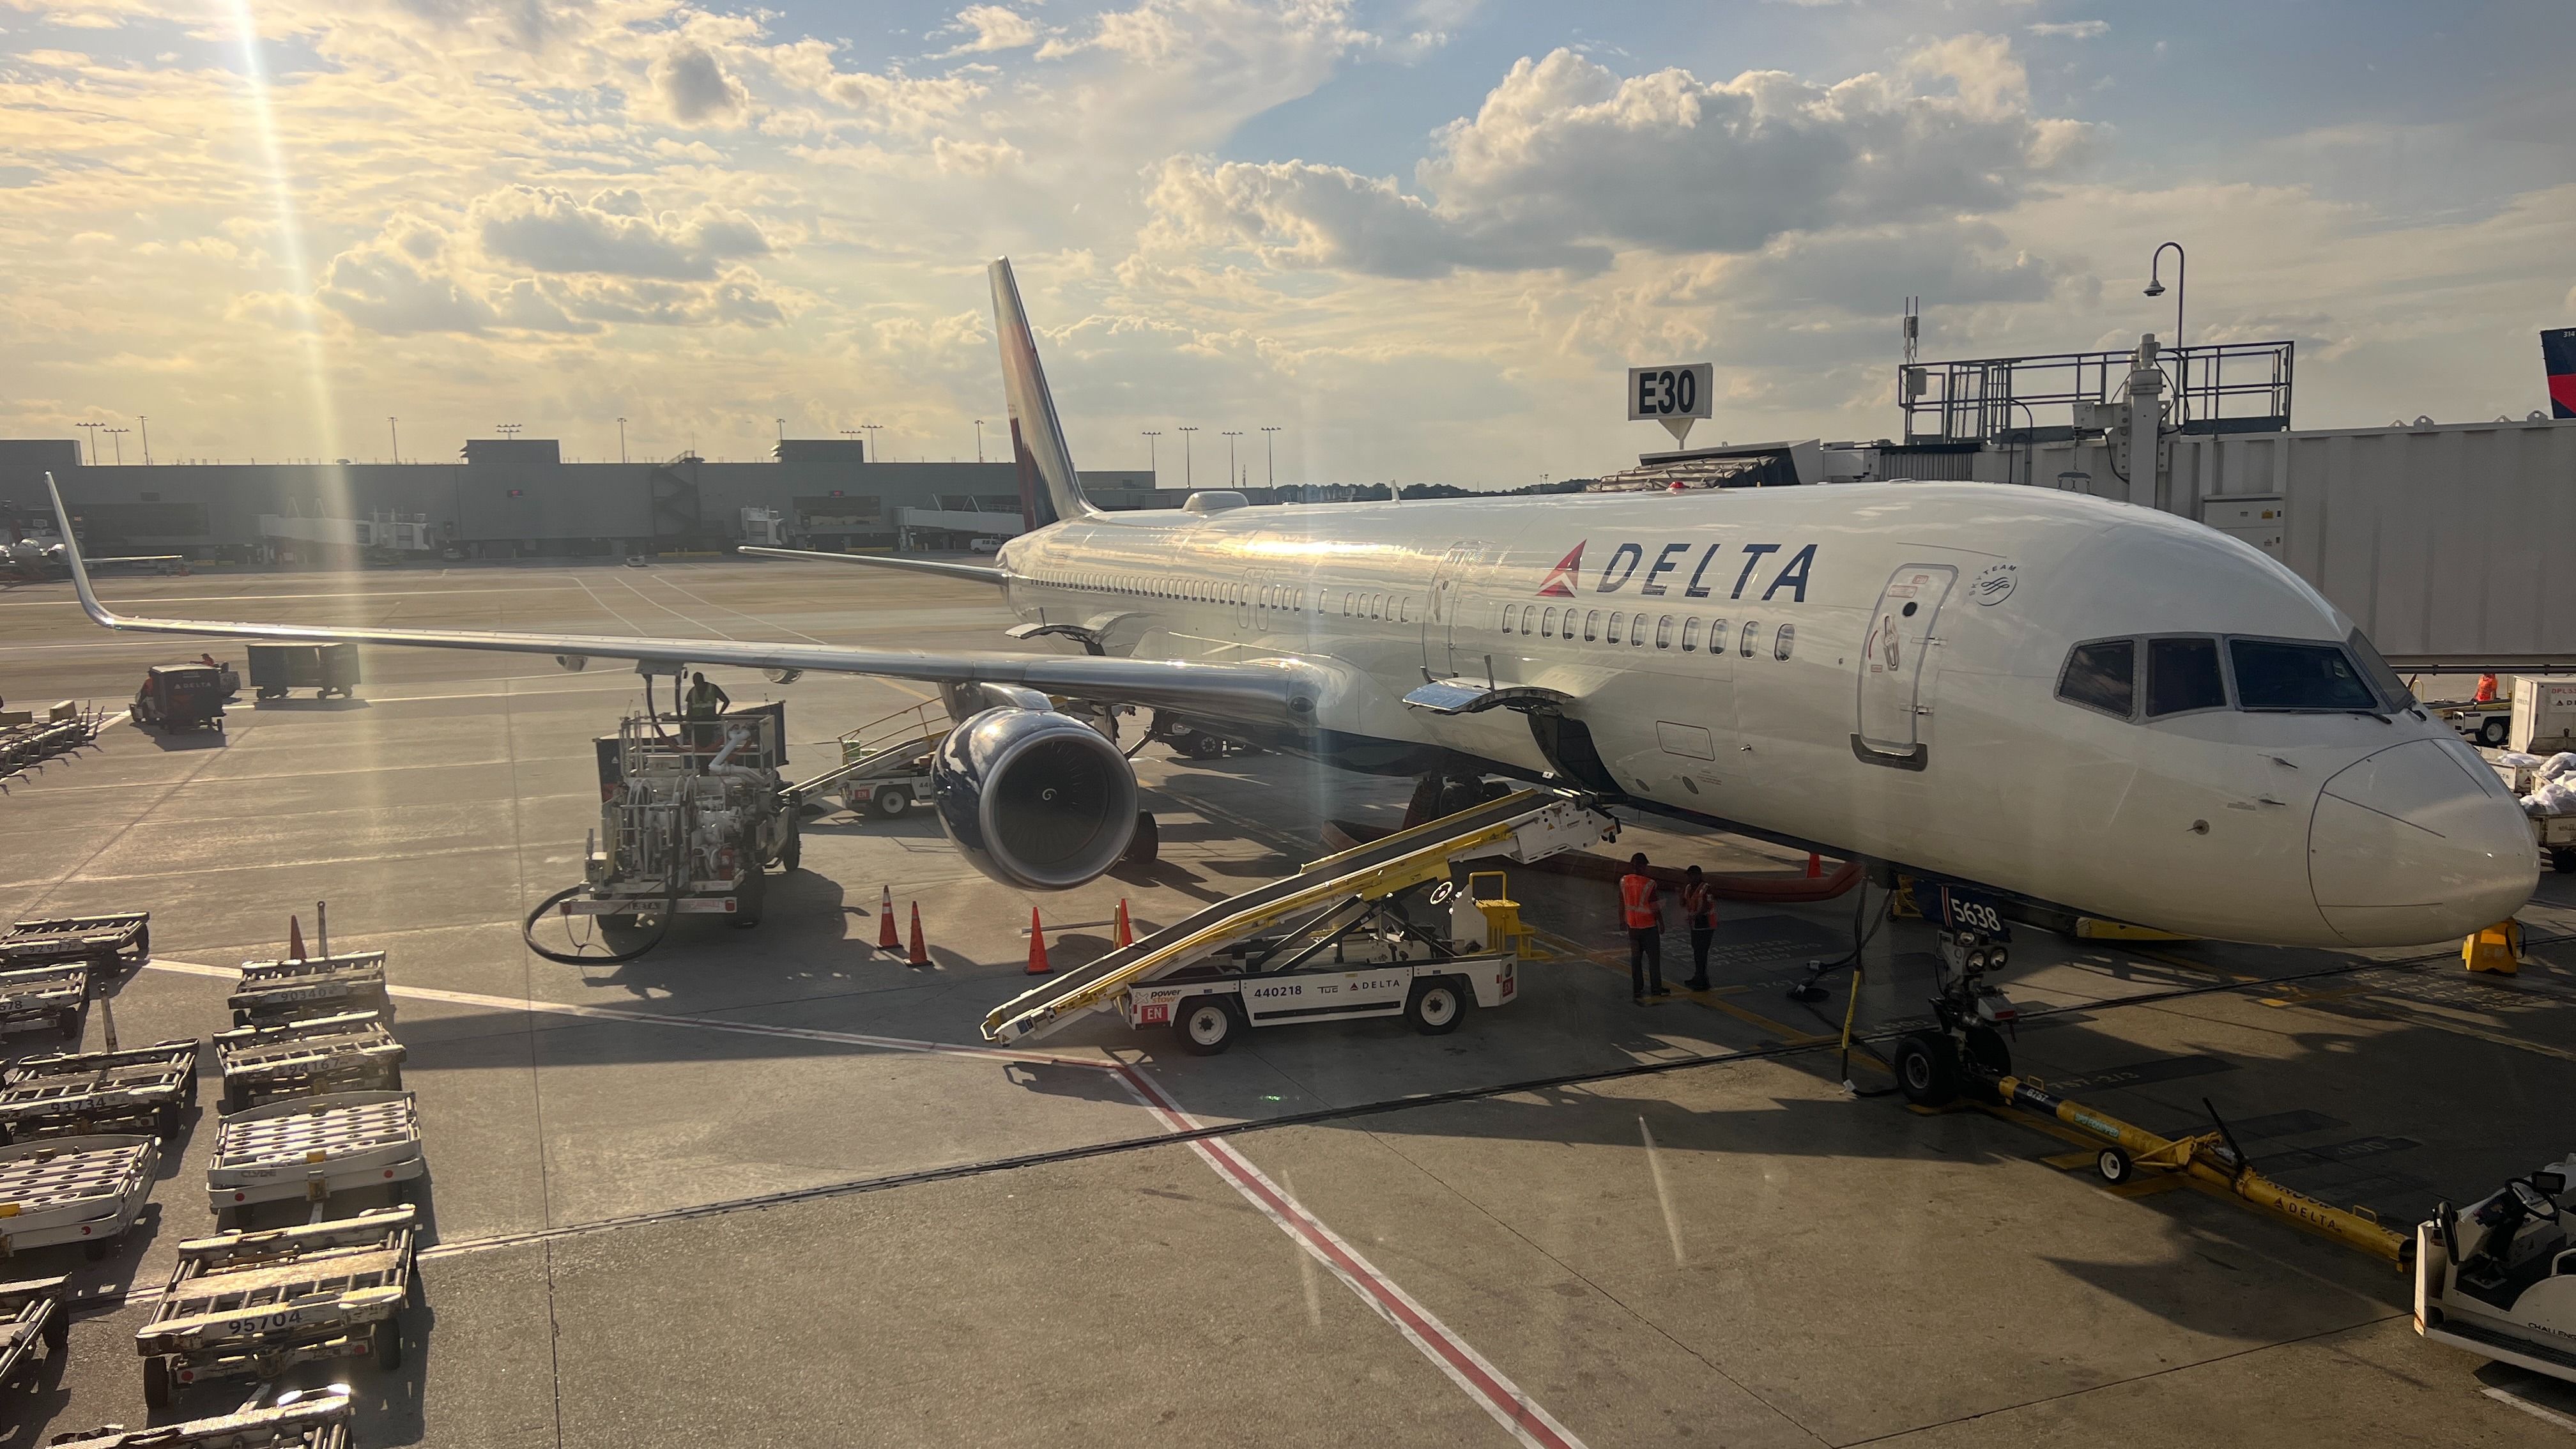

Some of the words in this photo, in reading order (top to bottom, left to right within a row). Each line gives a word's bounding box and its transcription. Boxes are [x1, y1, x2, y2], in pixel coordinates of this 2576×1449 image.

[1639, 369, 1696, 415] E30
[1597, 543, 1819, 602] DELTA
[1951, 898, 2002, 932] 5638
[29, 944, 72, 953] 92977
[281, 988, 326, 1000] 90340
[1151, 989, 1182, 999] power
[1254, 985, 1302, 997] 440218
[1361, 979, 1400, 990] DELTA
[1147, 1006, 1162, 1020] EN
[50, 1096, 105, 1112] 93734
[2289, 1202, 2335, 1228] DELTA
[228, 1308, 303, 1335] 95704
